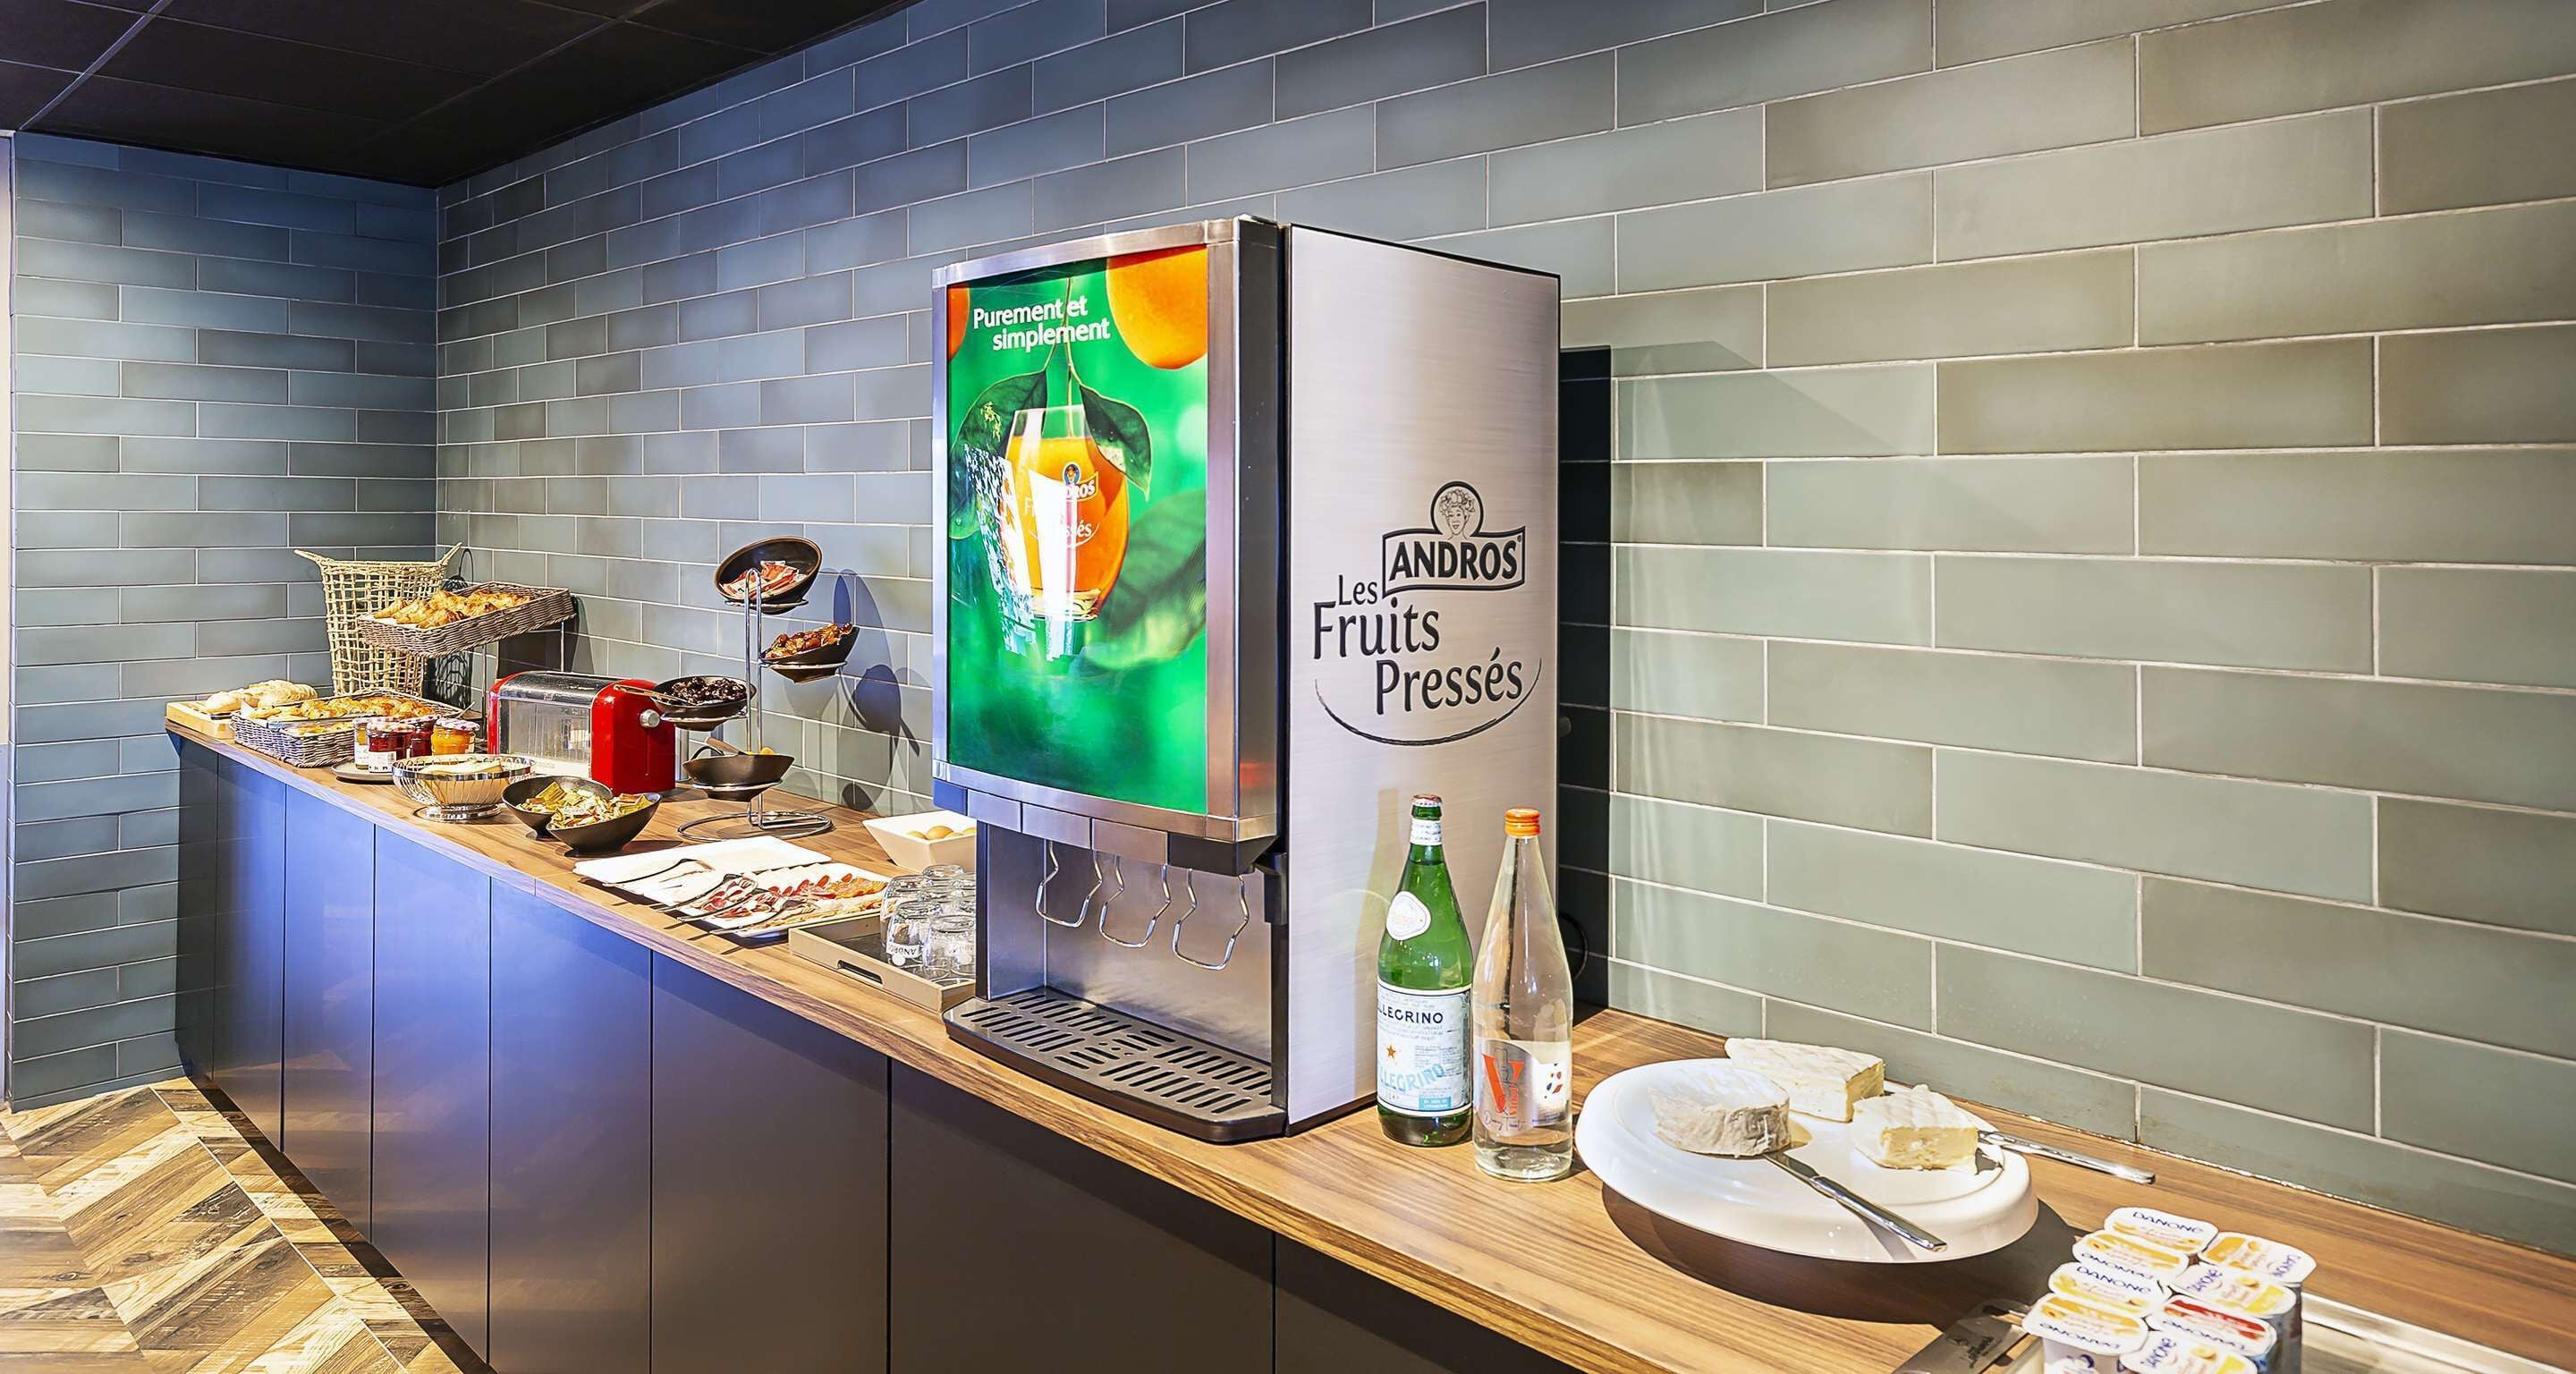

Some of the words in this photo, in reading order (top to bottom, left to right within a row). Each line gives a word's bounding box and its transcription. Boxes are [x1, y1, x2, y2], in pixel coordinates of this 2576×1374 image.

[973, 299, 1063, 329] Purement
[1066, 295, 1089, 317] et
[992, 318, 1111, 352] simplement
[1388, 539, 1518, 581] ANDROS
[1338, 574, 1378, 606] Les
[1313, 597, 1441, 660] Fruits
[1376, 646, 1523, 716] Pressés
